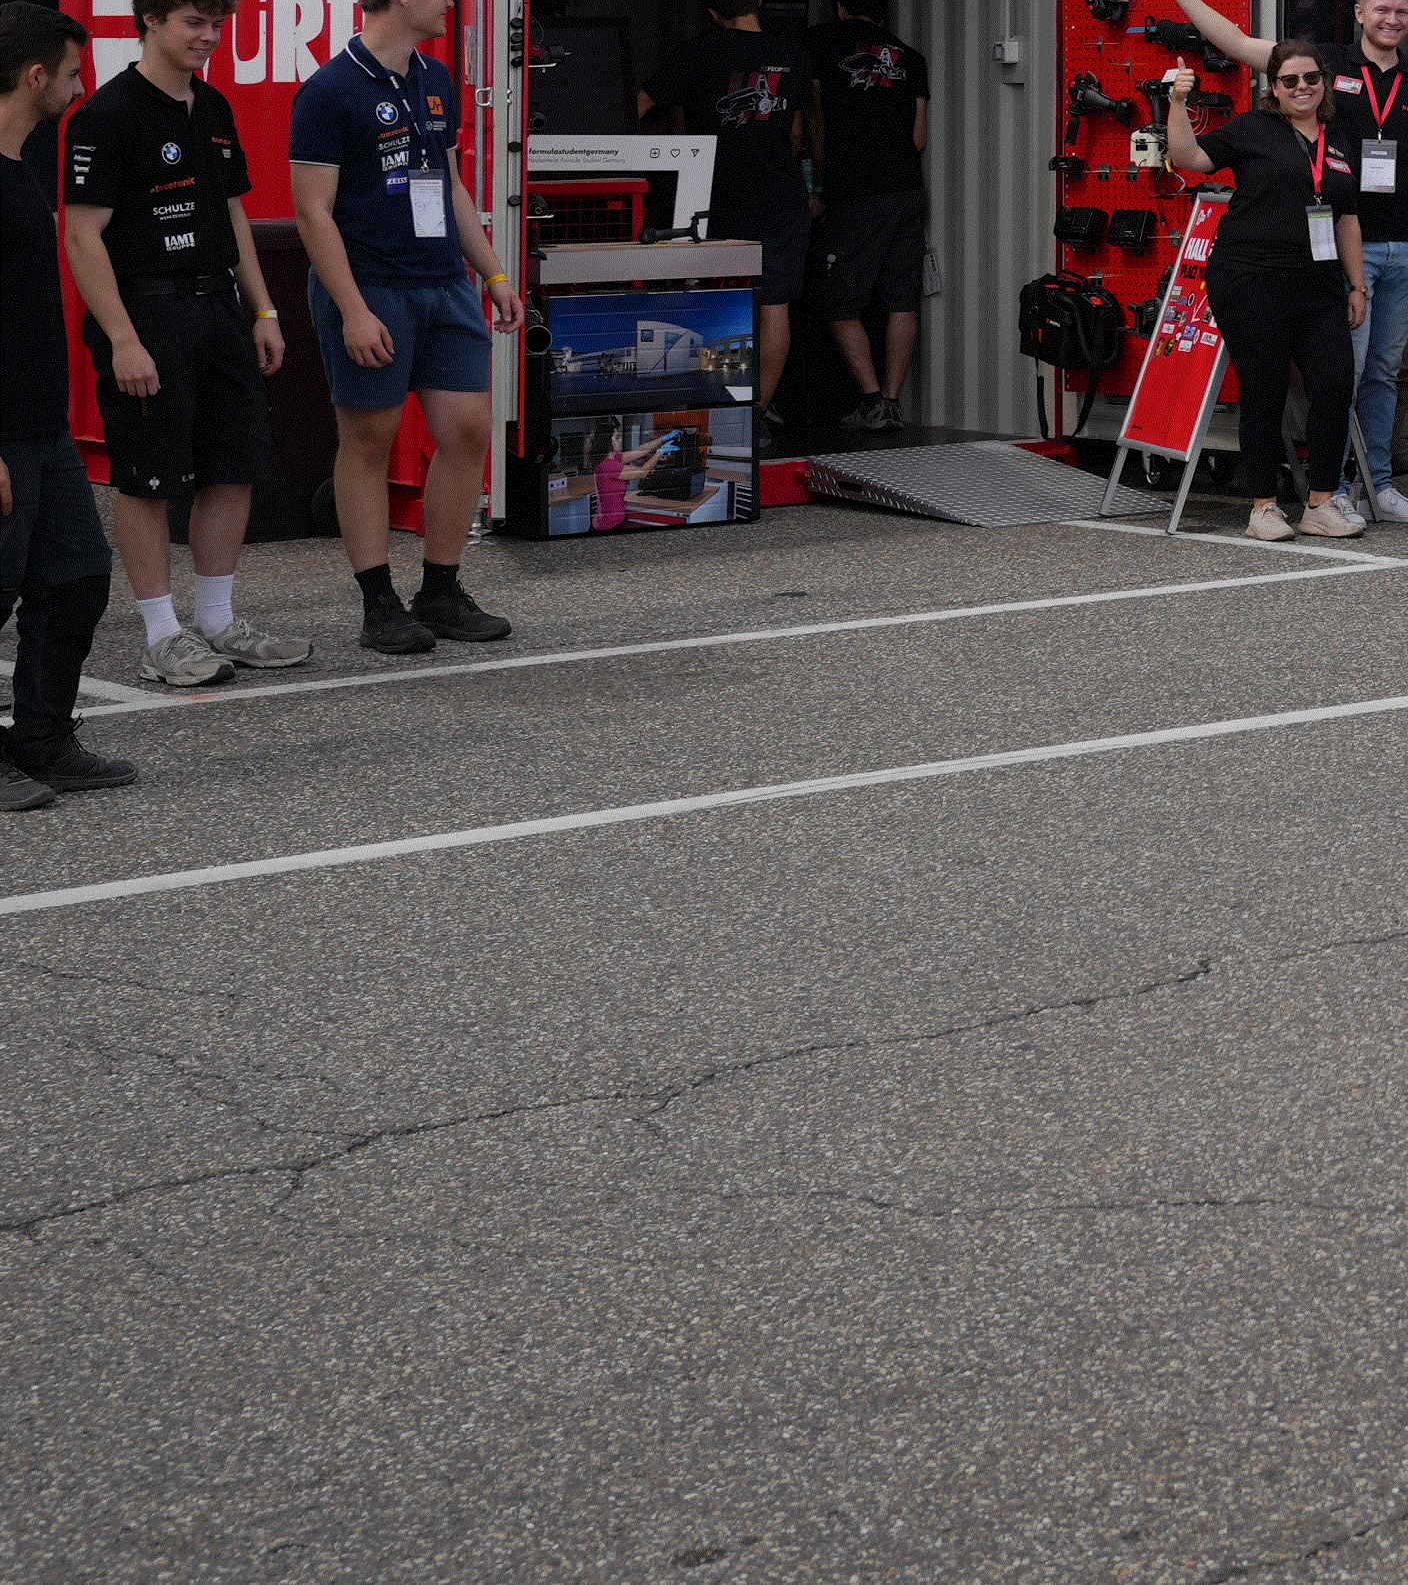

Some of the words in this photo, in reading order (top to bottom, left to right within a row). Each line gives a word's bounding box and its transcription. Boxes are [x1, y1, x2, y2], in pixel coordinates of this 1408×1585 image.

[152, 201, 196, 217] SCHULZE
[164, 231, 196, 248] IAMT
[1184, 237, 1209, 261] HALL
